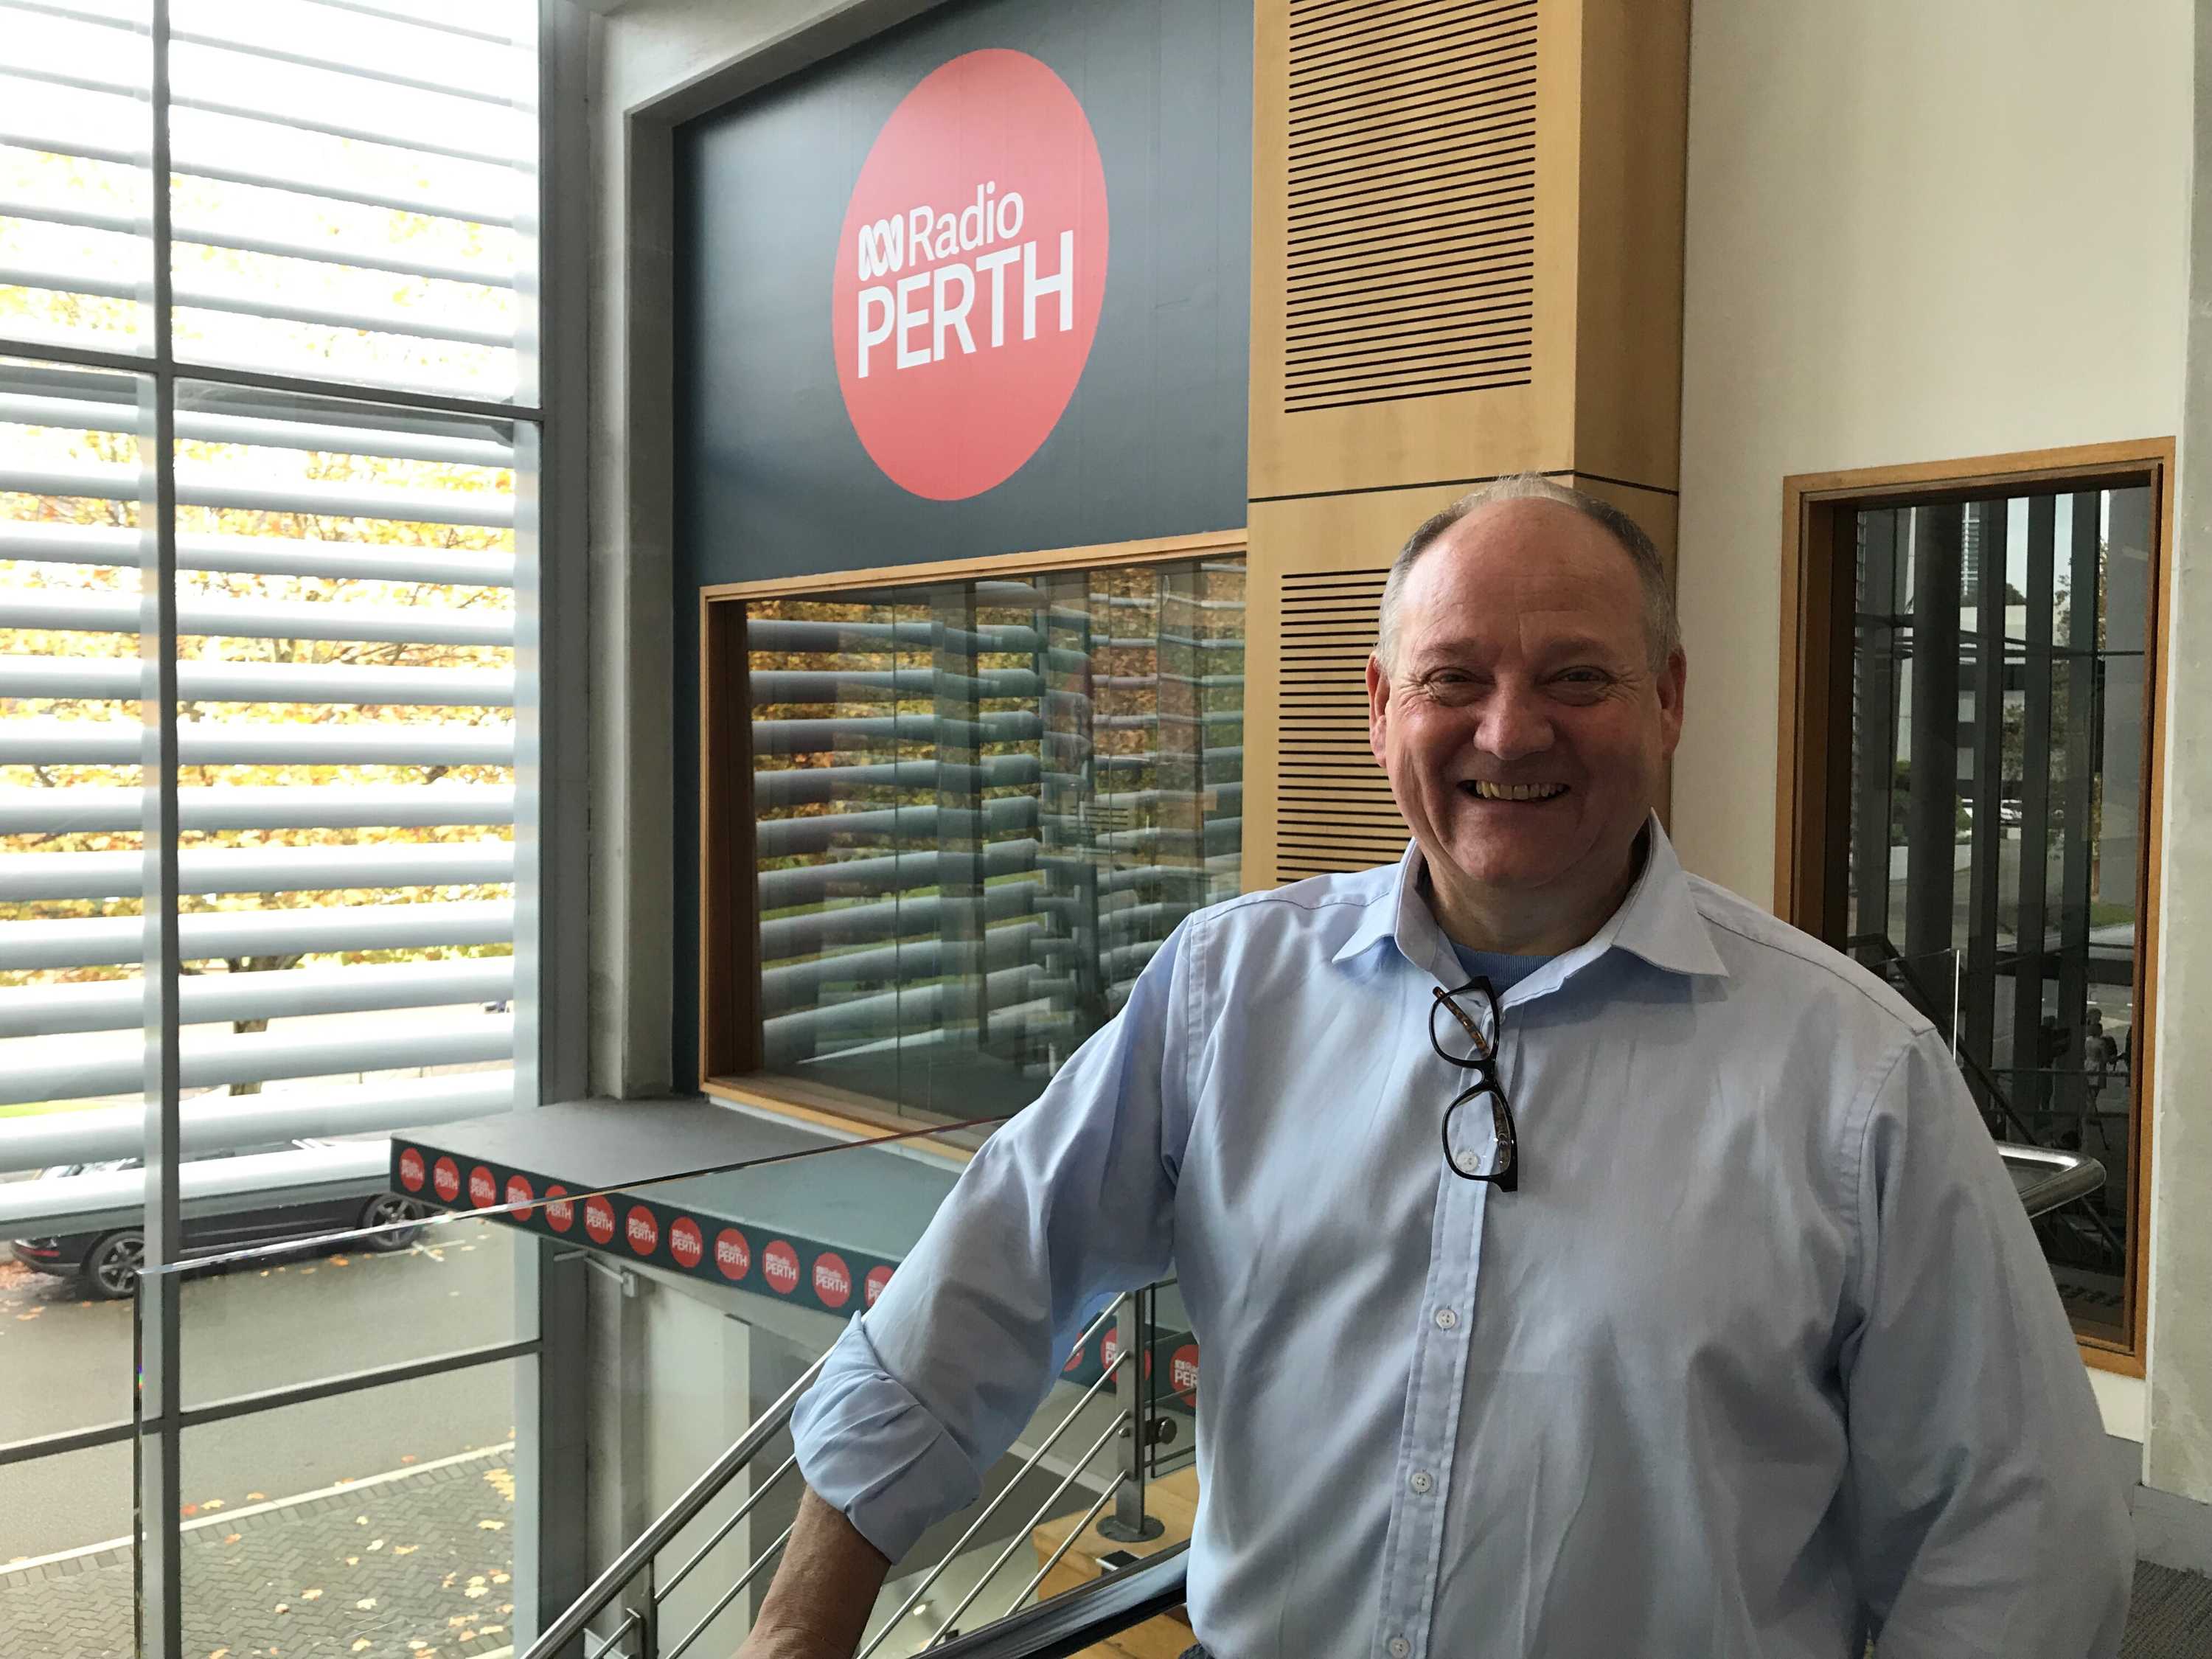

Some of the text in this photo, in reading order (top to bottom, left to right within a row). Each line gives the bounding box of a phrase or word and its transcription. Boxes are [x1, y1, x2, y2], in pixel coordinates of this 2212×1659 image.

[909, 181, 1024, 268] Radio
[858, 229, 1074, 379] PERTH
[587, 1214, 612, 1231] PERTH
[628, 1225, 655, 1243] PERTH
[672, 1238, 700, 1254] PERTH
[718, 1250, 747, 1267] PERTH
[766, 1262, 796, 1280] PERTH
[815, 1274, 847, 1294] PERTH
[1175, 1369, 1197, 1388] PER
